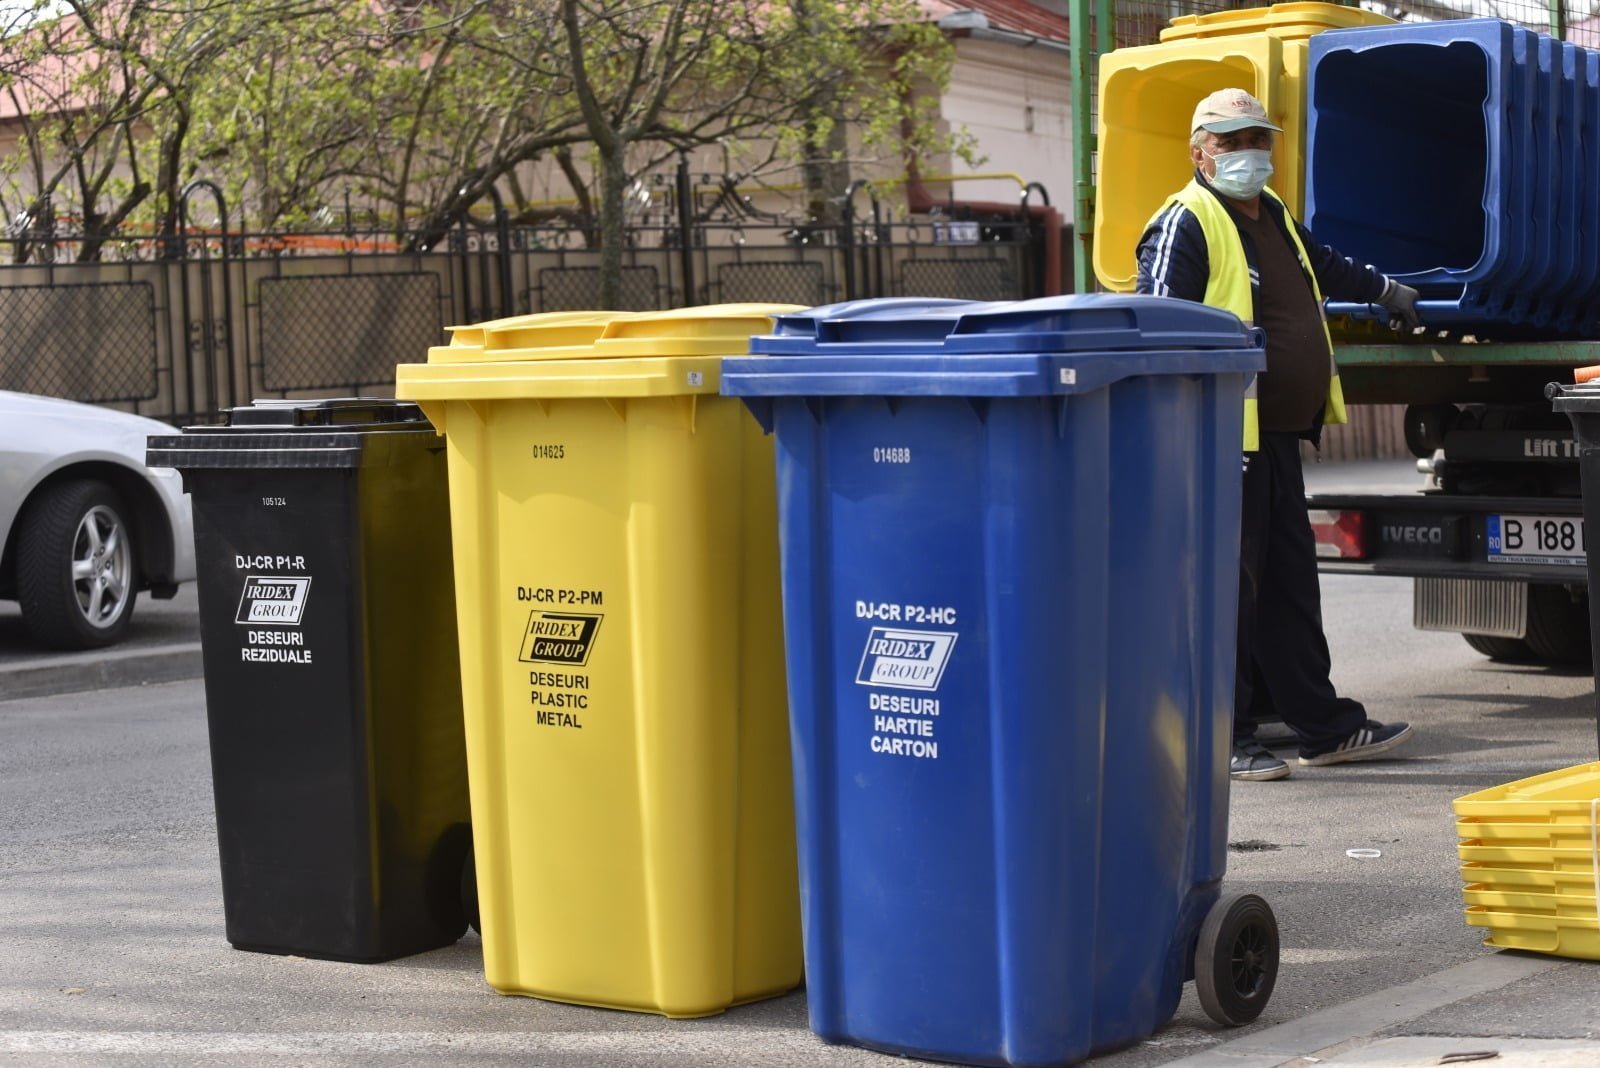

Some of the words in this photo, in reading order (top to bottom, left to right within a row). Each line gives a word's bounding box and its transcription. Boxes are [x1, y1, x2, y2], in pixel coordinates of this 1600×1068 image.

[533, 445, 565, 459] 014625
[873, 447, 911, 463] 014688
[1524, 438, 1559, 457] Lift
[262, 497, 287, 506] 105124
[1382, 526, 1442, 544] IVECO
[1488, 536, 1501, 550] RO
[1504, 519, 1524, 550] B
[1534, 520, 1576, 551] 188
[235, 555, 274, 569] DJ-CR
[276, 556, 306, 570] P1-R
[247, 585, 294, 600] IRIDEX
[517, 586, 555, 603] DJ-CR
[558, 589, 603, 605] P2-PM
[253, 604, 298, 617] GROUP
[855, 600, 902, 621] DJ-CR
[905, 605, 957, 625] P2-HC
[530, 620, 581, 637] IRIDEX
[248, 630, 304, 646] DESEURI
[241, 648, 313, 664] REZIDUALE
[534, 641, 585, 658] GROUP
[869, 638, 931, 659] IRIDEX
[530, 671, 589, 690] DESEURI
[876, 662, 935, 681] GROUP
[531, 690, 588, 709] PLASTIC
[869, 693, 940, 716] DESEURI
[537, 710, 582, 729] METAL
[874, 714, 934, 737] HARTIE
[870, 735, 938, 759] CARTON
